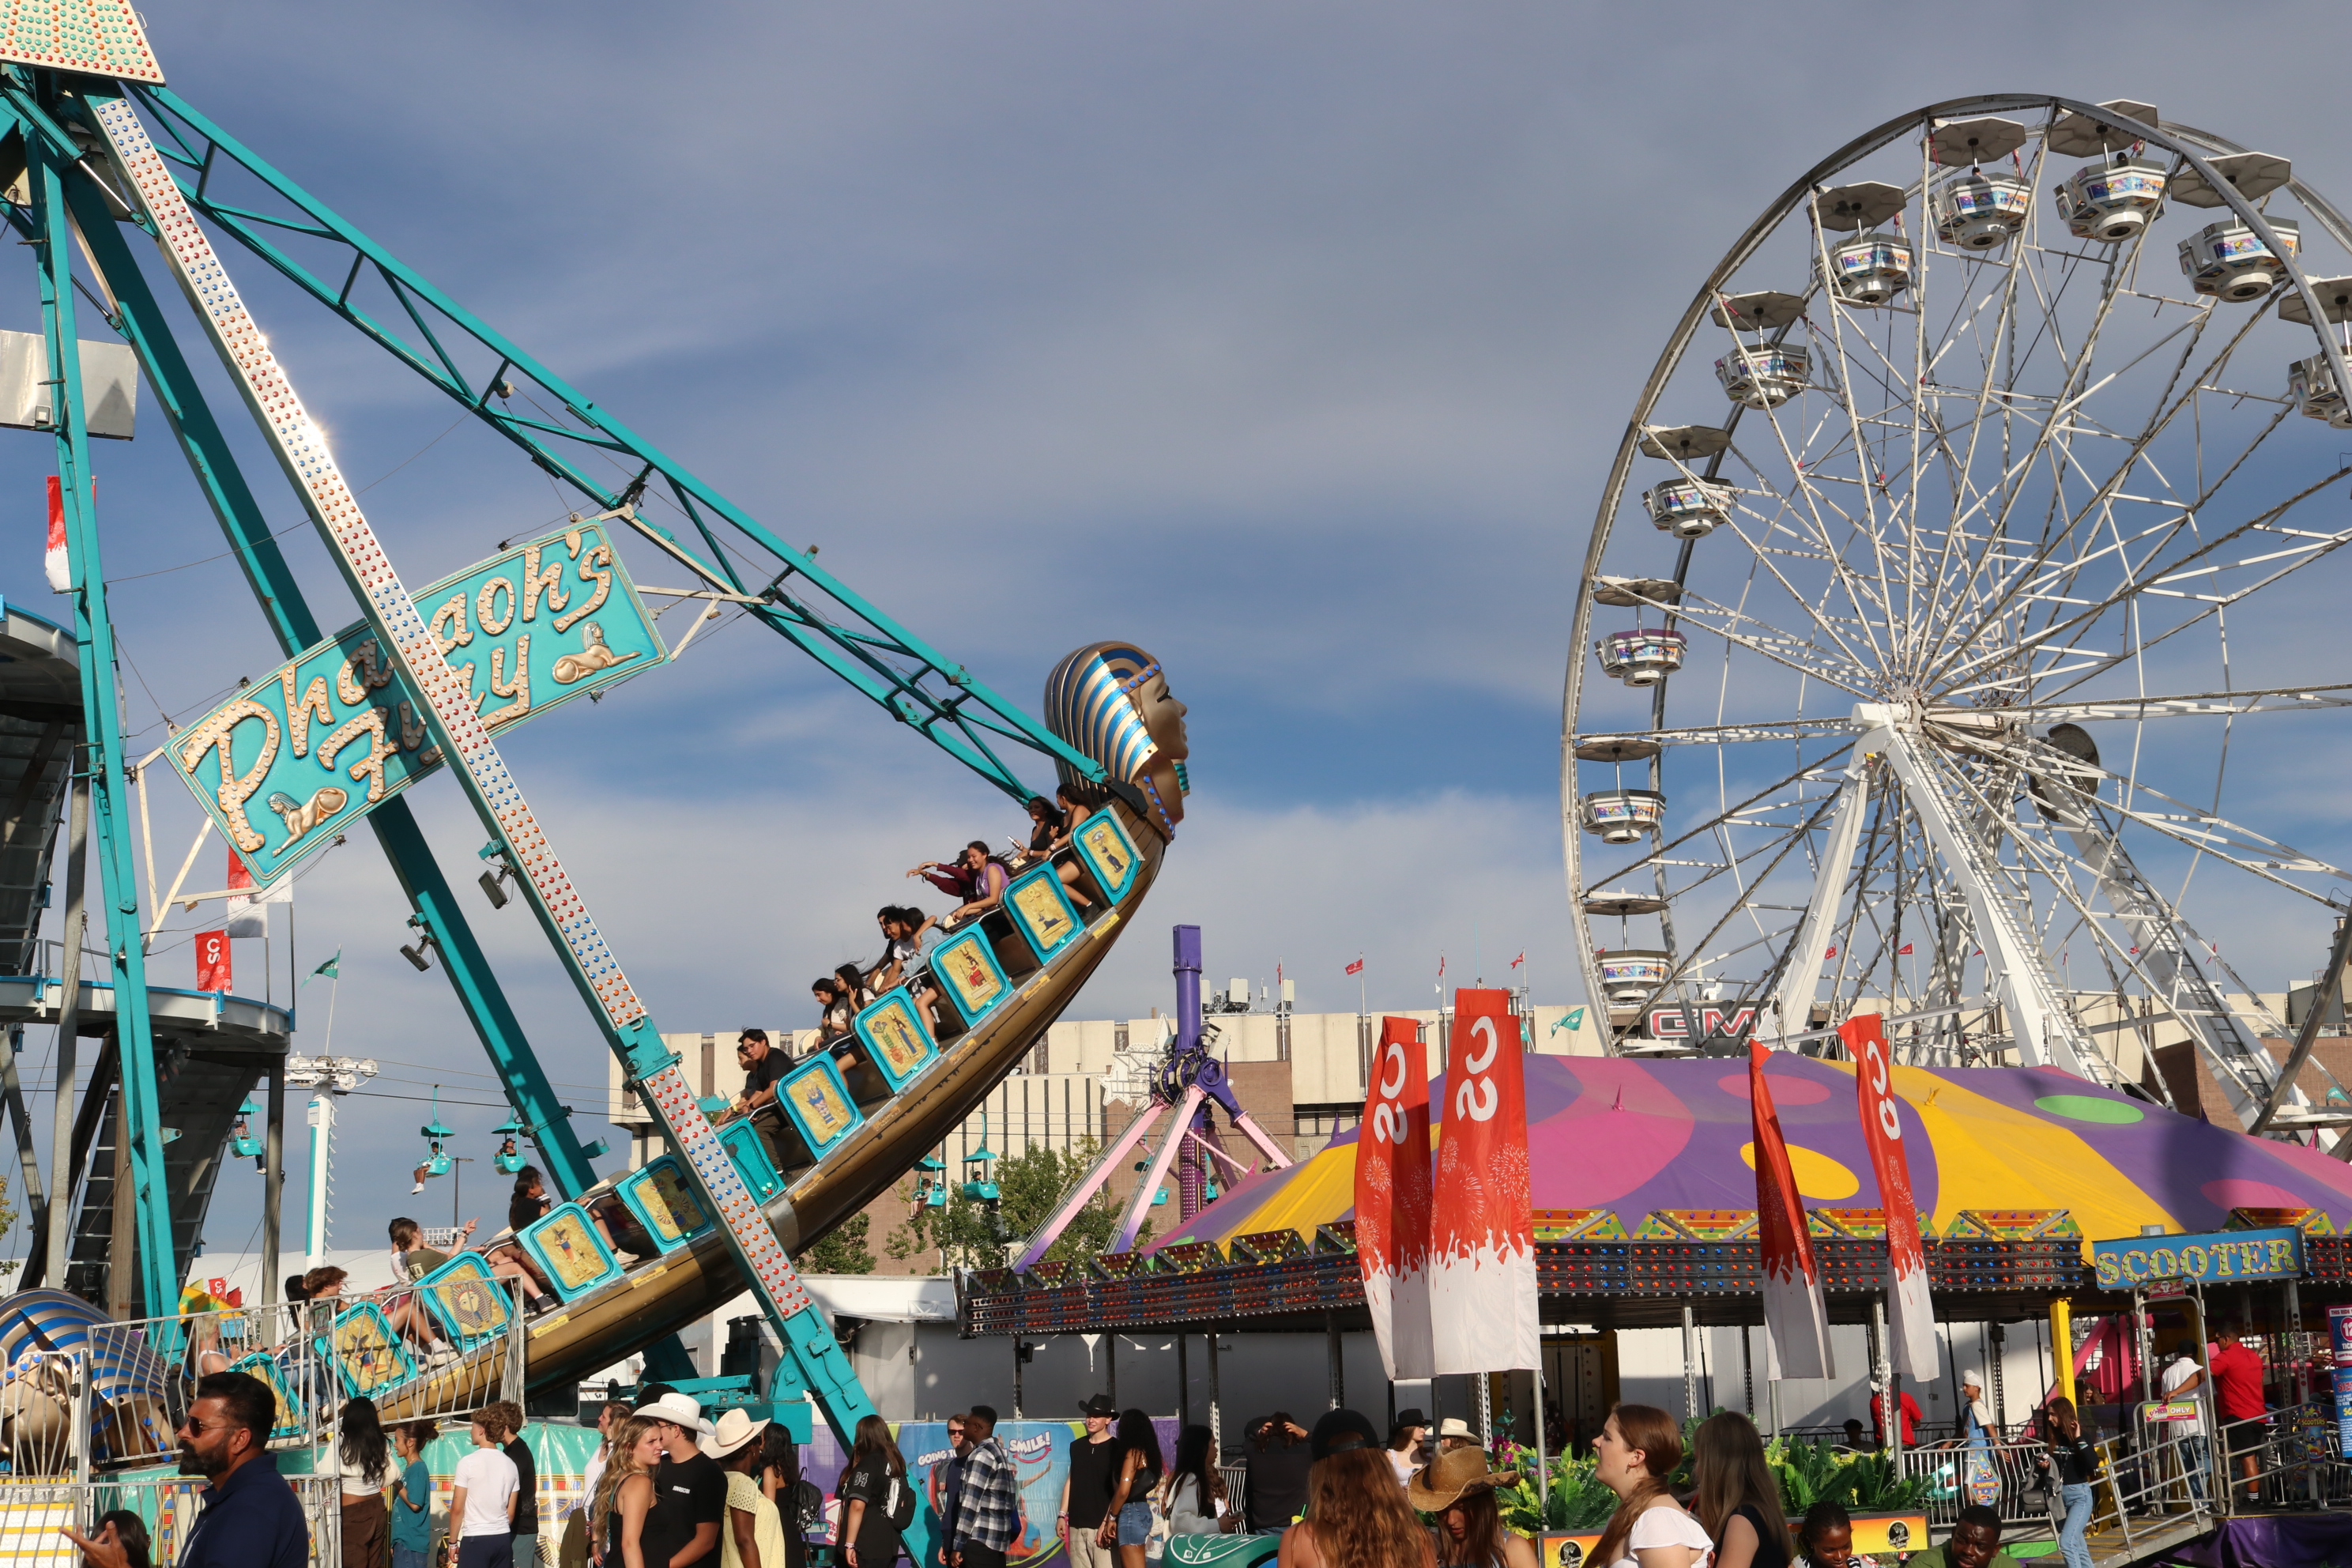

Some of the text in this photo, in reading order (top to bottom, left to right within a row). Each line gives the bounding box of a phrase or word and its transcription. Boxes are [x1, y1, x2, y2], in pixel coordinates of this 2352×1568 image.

[2204, 226, 2212, 236] 19
[183, 530, 611, 853] Phaaoh's
[2096, 1238, 2297, 1284] SCOOTER
[918, 1449, 947, 1466] GOING
[1009, 1431, 1051, 1455] SMILE!
[854, 1472, 869, 1487] 84
